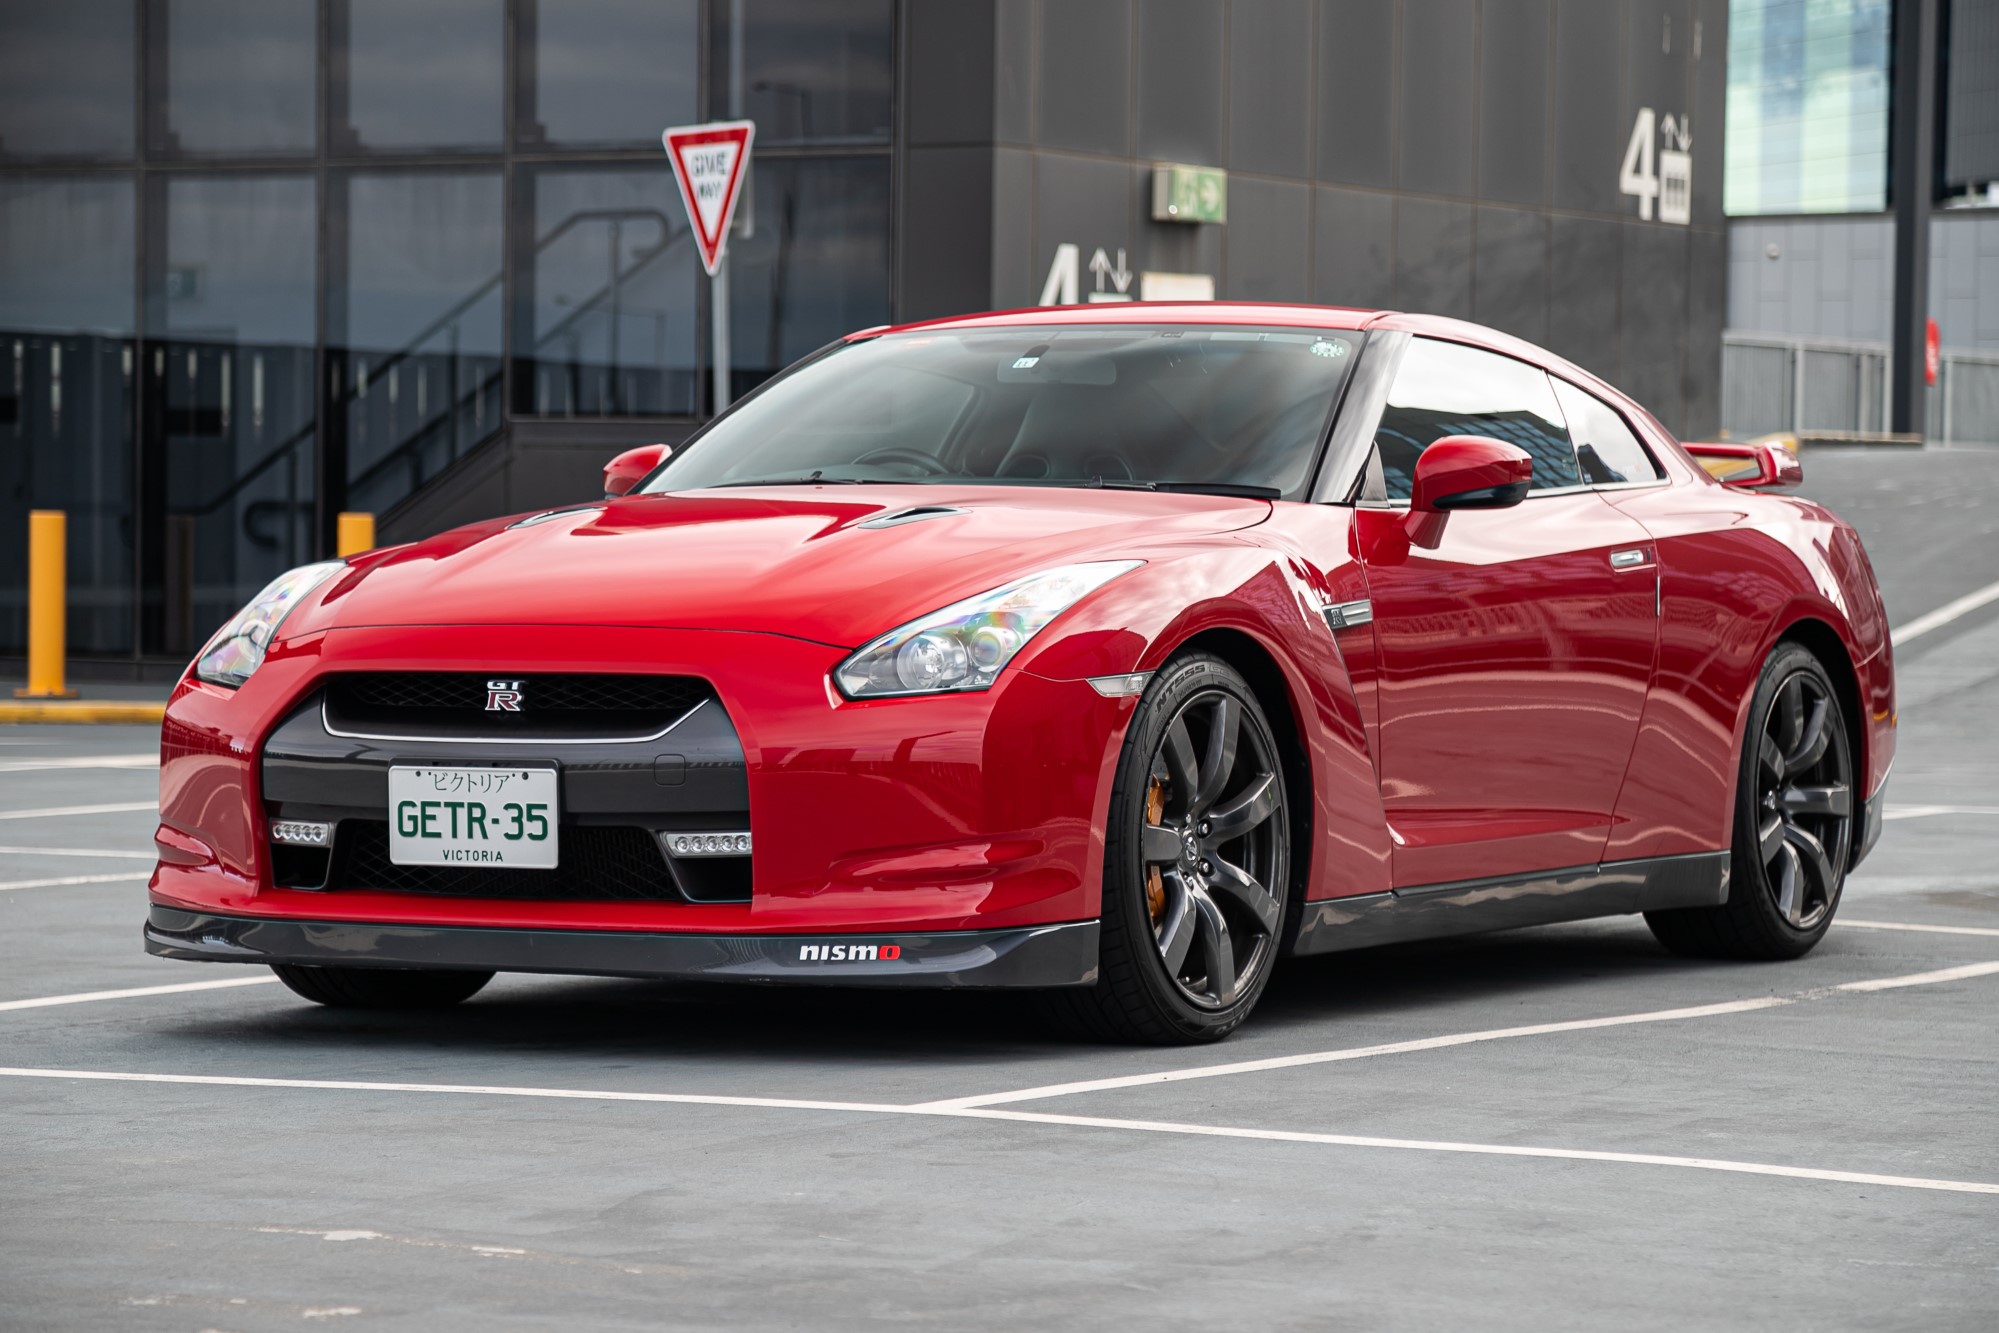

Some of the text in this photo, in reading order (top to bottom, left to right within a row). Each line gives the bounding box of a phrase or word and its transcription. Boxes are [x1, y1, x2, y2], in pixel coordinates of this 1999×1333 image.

[691, 151, 727, 177] GIVE
[1619, 106, 1659, 221] 4
[696, 181, 722, 199] WAY
[433, 772, 510, 794] ビクトリア
[397, 800, 549, 841] GETR-35
[442, 849, 504, 862] VICTORIA
[799, 945, 901, 961] nismo
